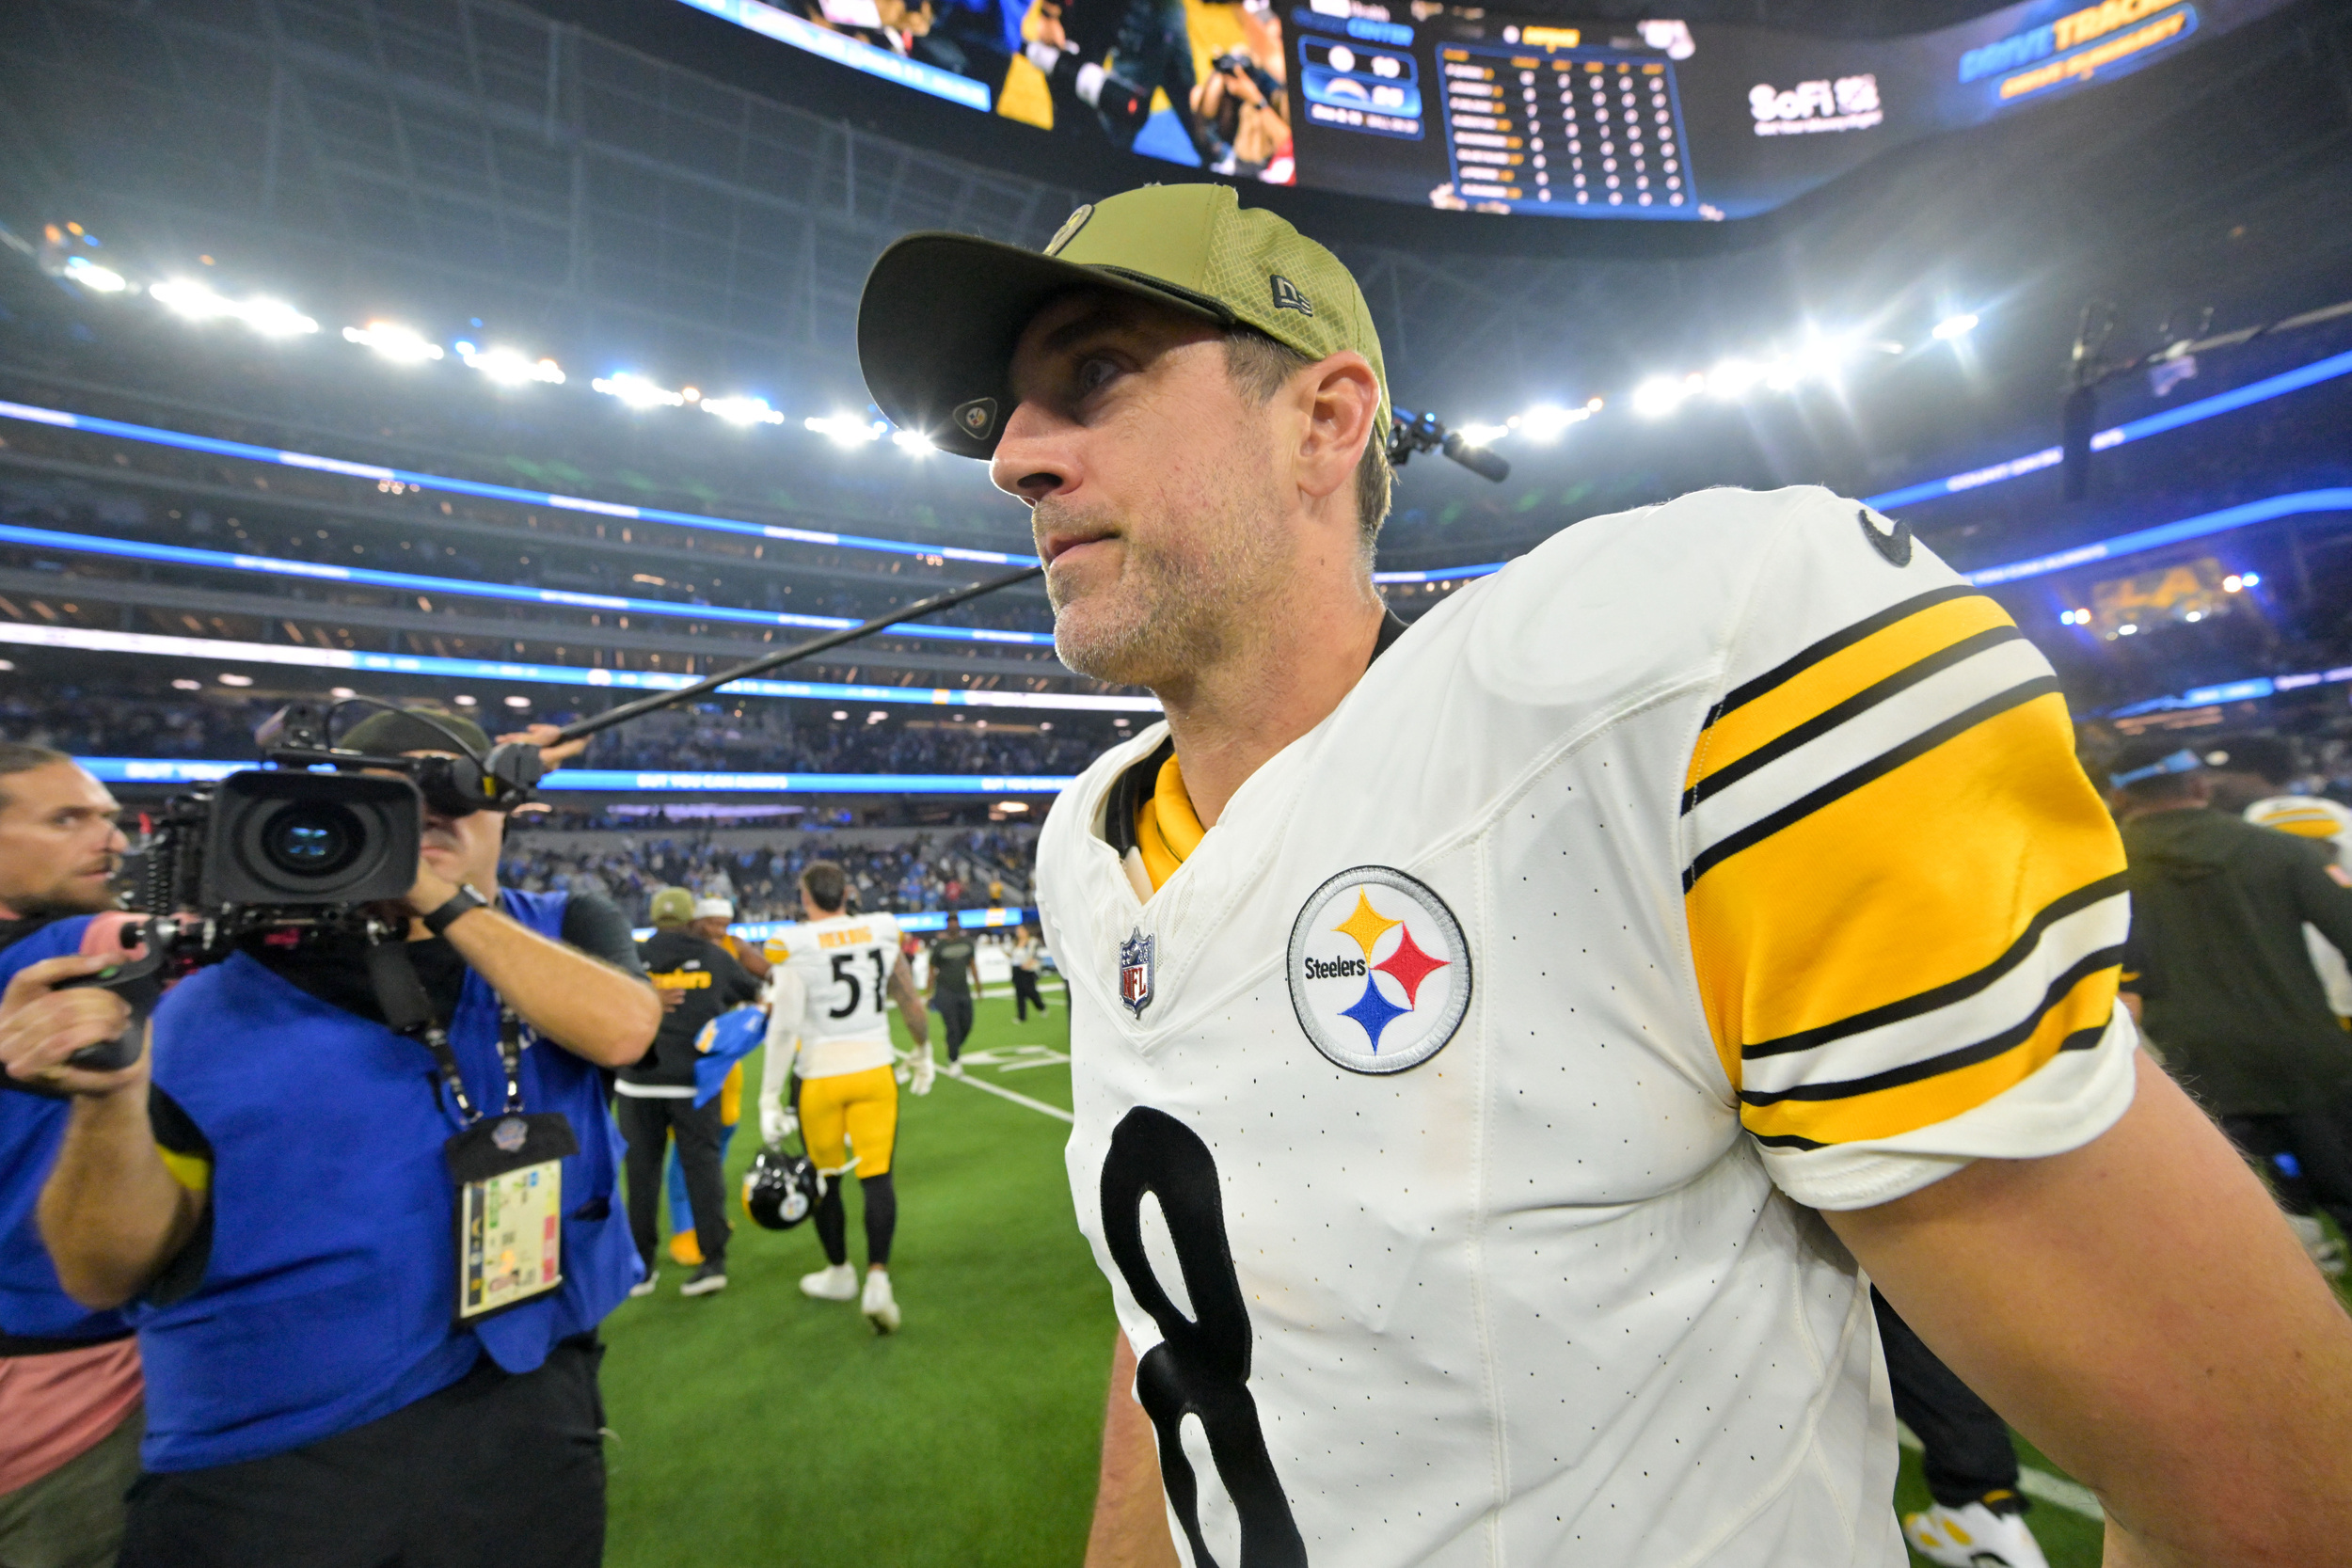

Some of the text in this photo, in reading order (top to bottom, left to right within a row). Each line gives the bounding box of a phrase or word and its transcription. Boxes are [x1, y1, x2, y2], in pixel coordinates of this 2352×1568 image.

[1749, 79, 1836, 121] SoFi
[829, 948, 883, 1020] 51
[1122, 967, 1147, 1002] NFL
[1304, 955, 1366, 979] Steelers
[1100, 1105, 1309, 1568] 8
